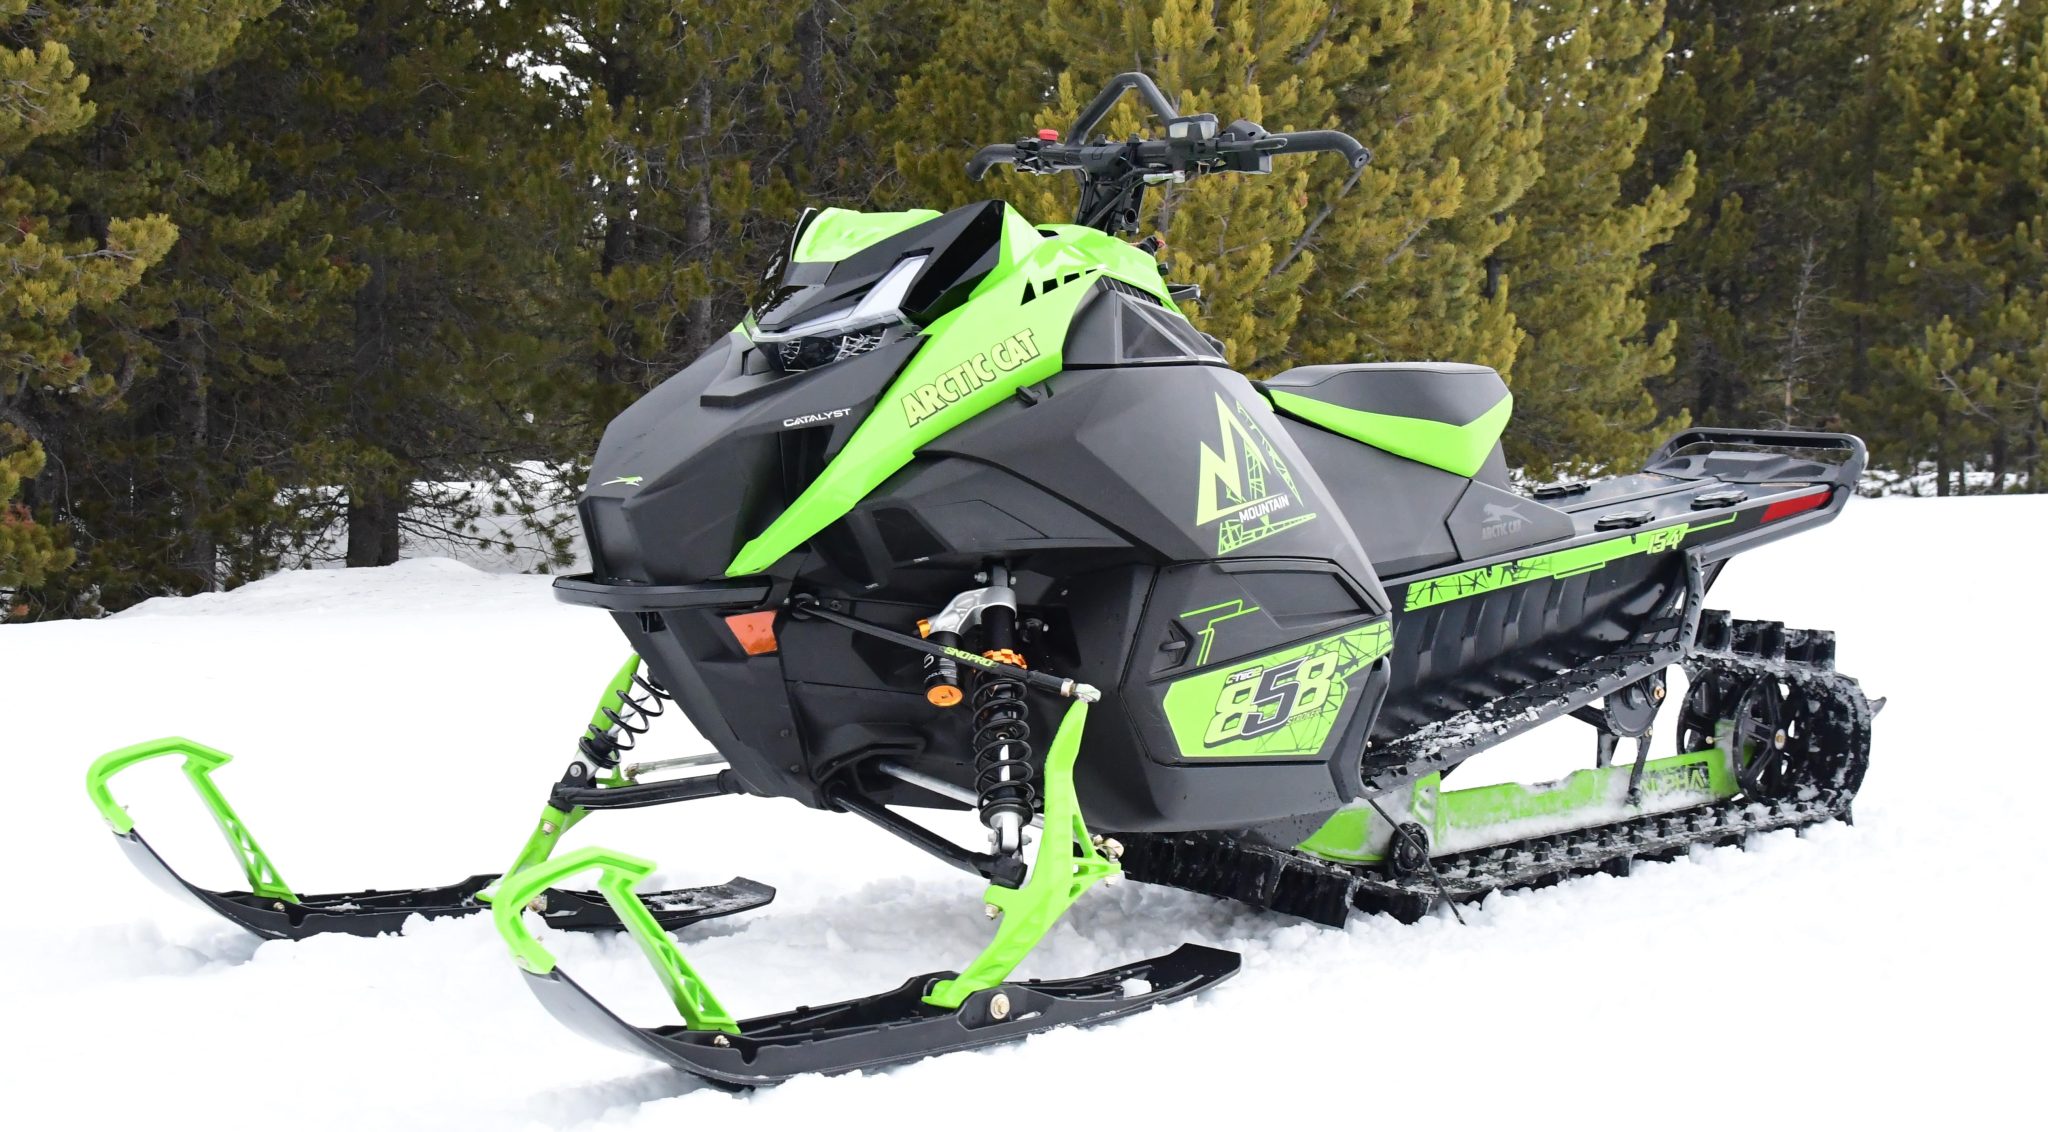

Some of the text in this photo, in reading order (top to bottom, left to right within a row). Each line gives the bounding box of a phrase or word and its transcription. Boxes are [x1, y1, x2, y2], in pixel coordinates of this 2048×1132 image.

[901, 327, 1041, 428] ARCTIC CAT
[783, 408, 852, 427] CATALYST
[1238, 494, 1290, 523] MOUNTAIN
[1481, 519, 1521, 540] ARCTIC CAT
[1647, 530, 1682, 555] 154
[1203, 651, 1340, 749] 858
